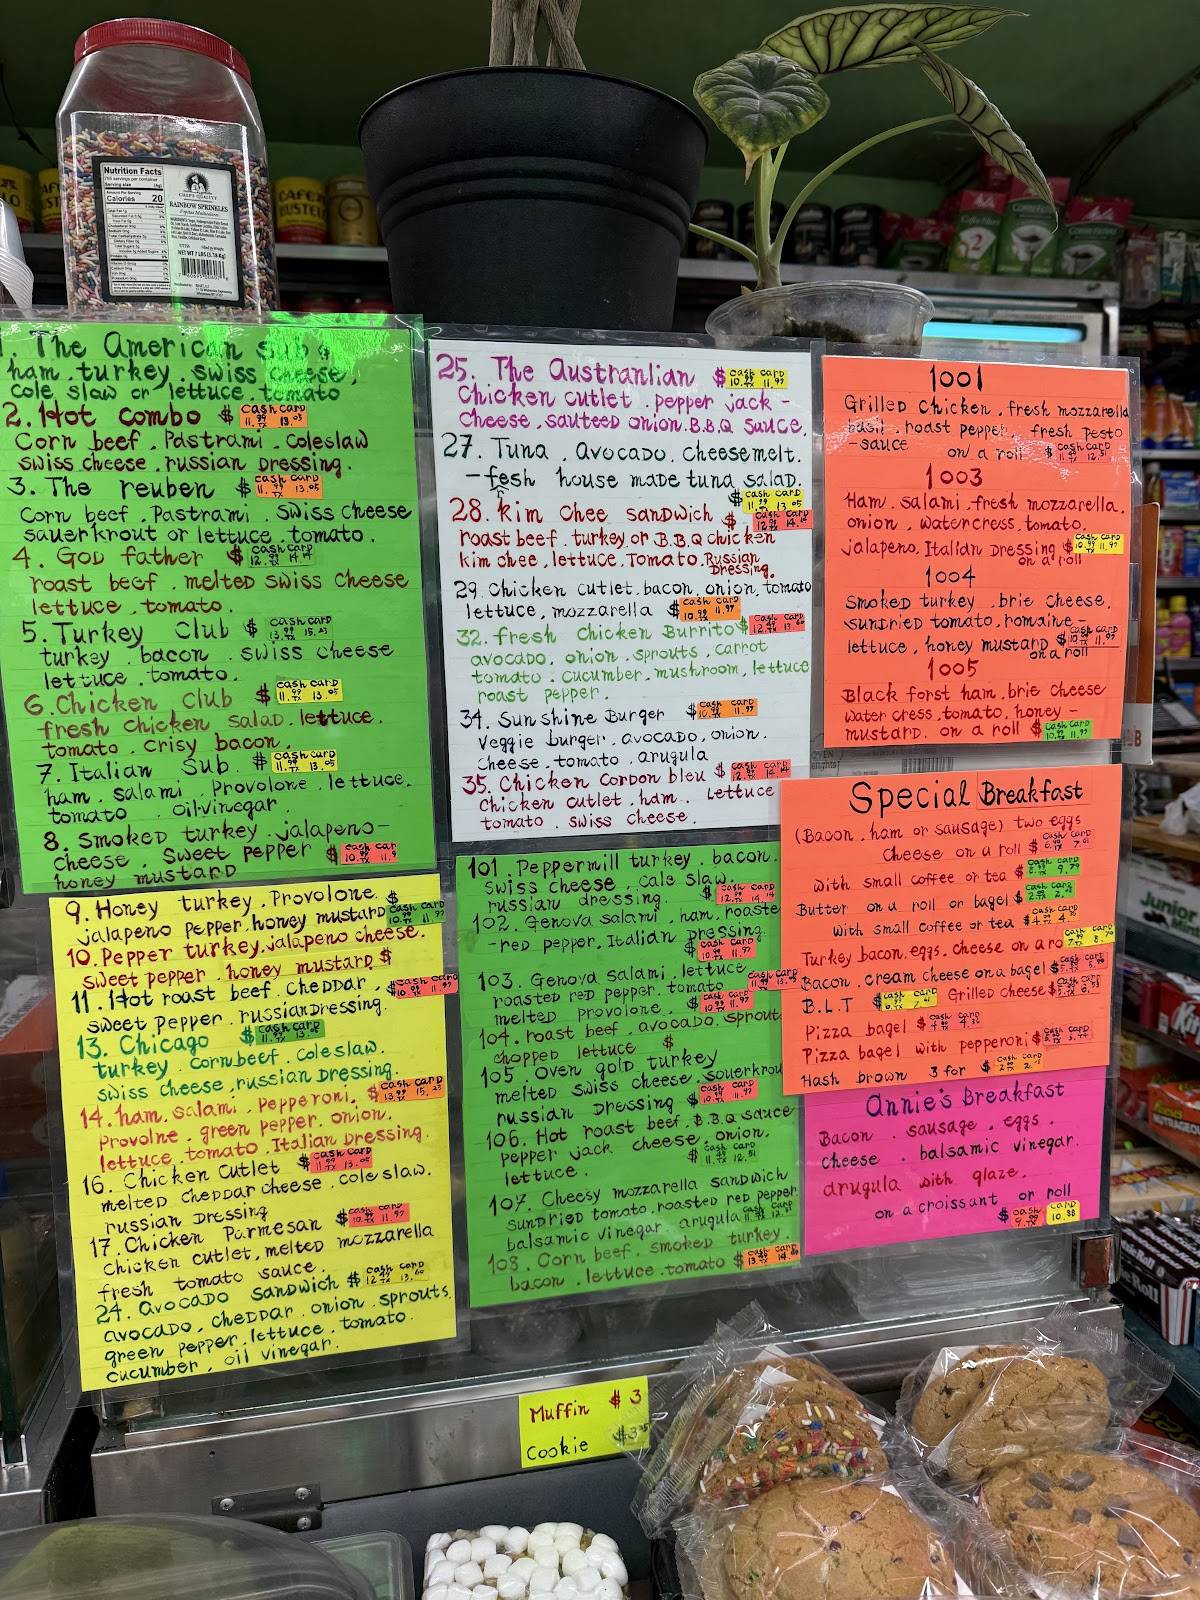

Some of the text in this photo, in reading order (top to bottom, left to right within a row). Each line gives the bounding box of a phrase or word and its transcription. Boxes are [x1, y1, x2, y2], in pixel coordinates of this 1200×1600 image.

[971, 234, 982, 250] 2
[30, 331, 86, 358] The
[77, 364, 170, 390] turkey
[491, 355, 533, 382] The
[930, 364, 982, 392] 1001
[170, 381, 243, 401] lettuce
[656, 391, 772, 414] pepper jack
[1010, 401, 1050, 417] fresh
[40, 404, 96, 428] Hot
[905, 421, 1072, 438] roast fresh
[16, 430, 262, 451] Corn beef Pastrami
[491, 437, 548, 459] Tuna
[166, 454, 245, 471] russian
[556, 466, 734, 489] house tuna
[927, 463, 982, 490] 1003
[7, 477, 214, 498] 3. The reuben
[844, 494, 887, 509] Ham
[86, 504, 249, 525] beef Pastrami
[848, 515, 898, 528] onion
[168, 527, 271, 544] or lettuce
[460, 528, 624, 551] roast beef turkey
[126, 547, 203, 569] father
[925, 540, 982, 556] Italian
[31, 574, 157, 592] roast beef
[926, 565, 975, 588] 1004
[766, 582, 812, 593] tomato
[552, 604, 652, 618] mozzarella
[920, 594, 974, 614] turkey
[54, 621, 143, 646] Turkey
[494, 622, 734, 645] fresh Burrito
[634, 643, 698, 661] sprouts
[925, 638, 972, 653] honey
[40, 646, 208, 667] turkey bacon
[753, 660, 809, 675] lettuce
[928, 658, 979, 679] 1005
[841, 683, 996, 702] Black ham
[605, 710, 664, 724] Burger
[1016, 705, 1061, 720] honey
[973, 721, 1019, 736] a roll
[72, 761, 152, 780] Italian
[669, 768, 706, 782] bleu
[45, 787, 90, 807] ham
[850, 777, 1083, 818] Special Breakfast
[48, 808, 127, 824] tomato
[1015, 814, 1080, 829] two eggs
[186, 822, 257, 842] turkey
[999, 844, 1020, 855] roll
[517, 853, 690, 879] Peppermill turkey
[55, 875, 114, 890] honey
[864, 870, 1006, 888] small tea
[96, 891, 252, 919] Honey turkey
[488, 896, 560, 913] russian
[797, 896, 1008, 916] Butter roll bagel
[1140, 891, 1198, 921] Junior
[78, 913, 306, 947] jalapeno honey
[607, 928, 675, 946] Italian
[102, 945, 172, 967] Pepper
[802, 950, 851, 968] Turkey
[226, 964, 281, 981] honey
[682, 961, 747, 976] lettuce
[1011, 962, 1046, 978] bagel
[110, 982, 269, 1008] Hot roast beef
[527, 1023, 618, 1042] roast beef
[806, 1023, 906, 1039] Pizza bagel
[120, 1034, 209, 1057] Chicago
[802, 1032, 1027, 1063] Pizza bagel pepperoni
[648, 1049, 717, 1070] turkey
[802, 1064, 965, 1087] Hash brown 3 for
[963, 1080, 1064, 1106] Breakfast
[200, 1122, 249, 1141] green
[1004, 1115, 1039, 1131] eggs
[536, 1124, 634, 1144] Hot roast
[185, 1136, 336, 1160] tomato Italian
[570, 1143, 613, 1160] jack
[920, 1140, 999, 1160] balsamic
[124, 1165, 209, 1189] Chicken
[613, 1179, 697, 1200] mozzarella
[1048, 1184, 1071, 1199] roll
[226, 1218, 322, 1240] Parmesan
[338, 1225, 434, 1247] mozzarella
[730, 1227, 780, 1244] turkey
[586, 1264, 654, 1285] lettuce
[98, 1271, 243, 1302] fresh tomato
[1132, 1275, 1159, 1304] Roll
[105, 1347, 164, 1367] green
[224, 1349, 248, 1364] oil
[530, 1389, 641, 1423] Muffin $ 3
[527, 1436, 588, 1460] Cookie
